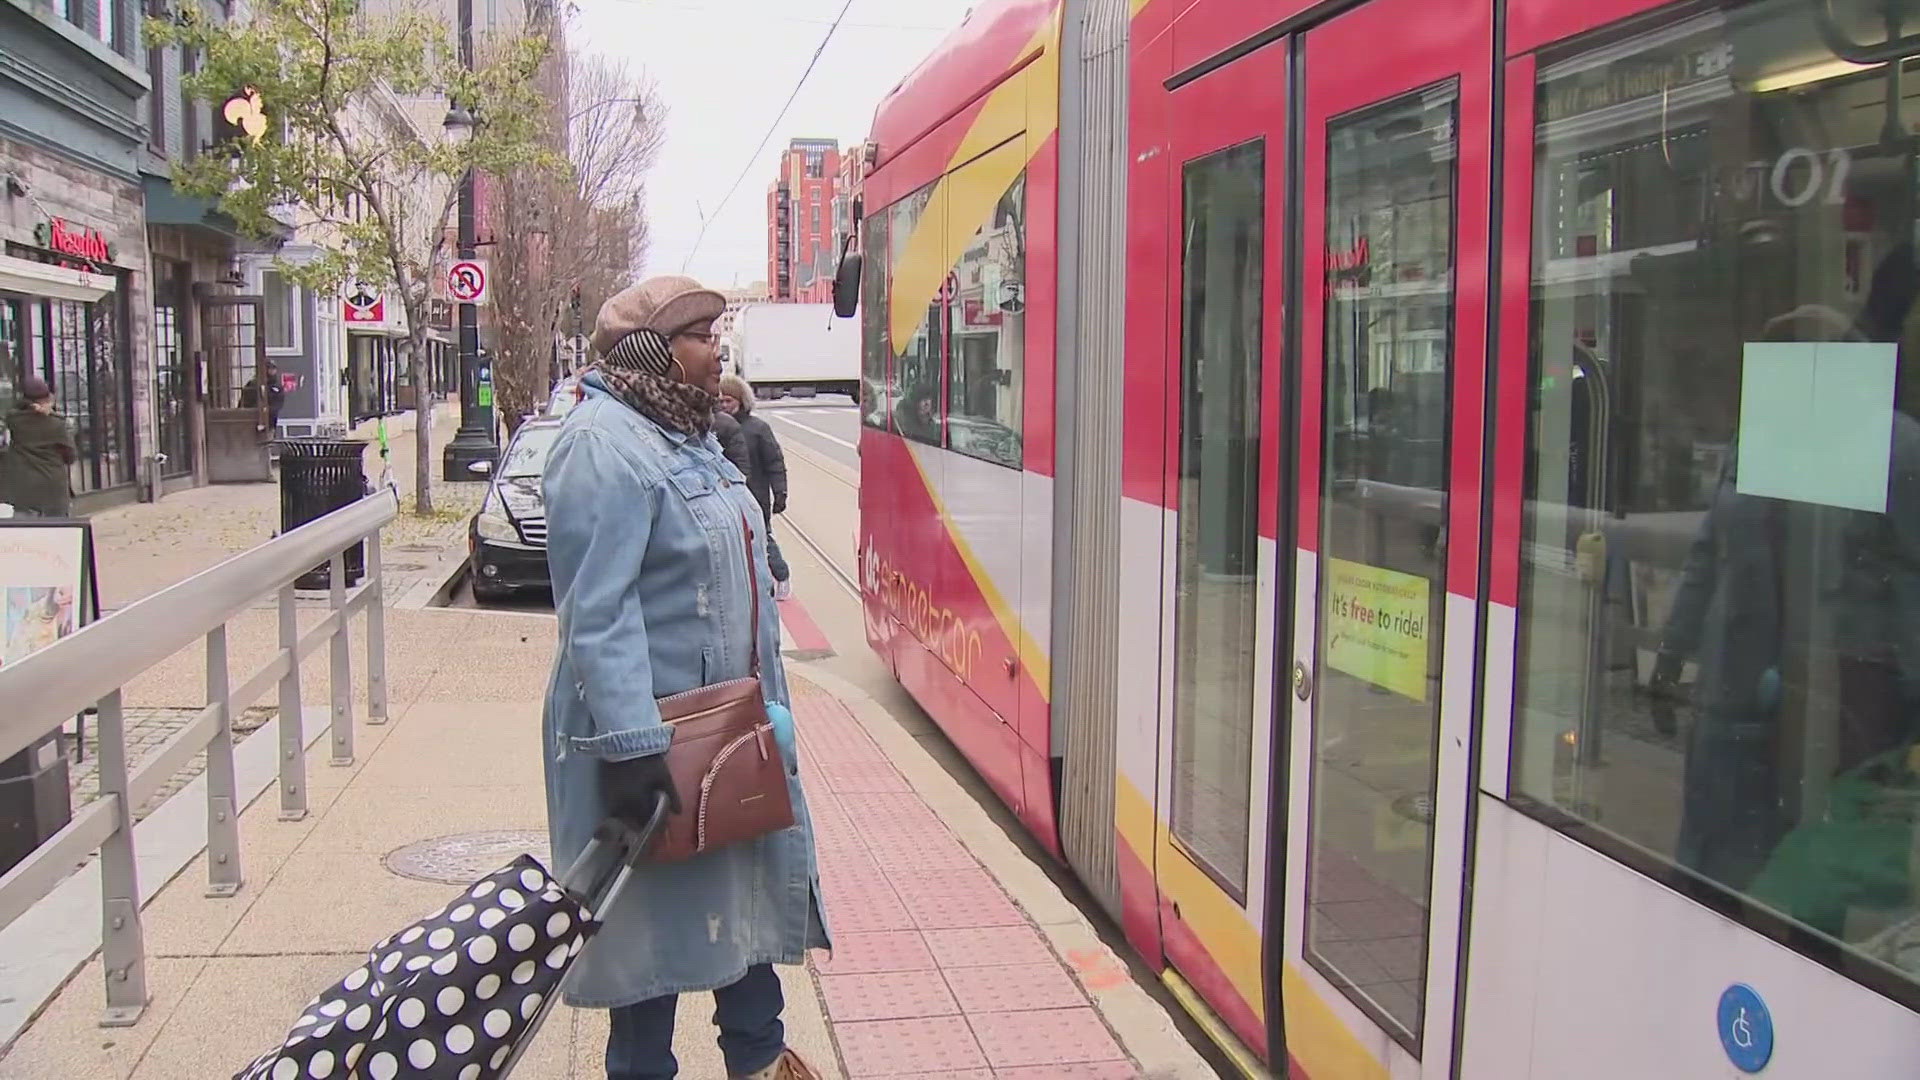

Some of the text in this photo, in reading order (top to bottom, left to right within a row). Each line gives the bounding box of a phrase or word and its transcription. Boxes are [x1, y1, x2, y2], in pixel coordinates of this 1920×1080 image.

[881, 552, 983, 681] streetcar
[1332, 592, 1424, 639] It's free to ride!
